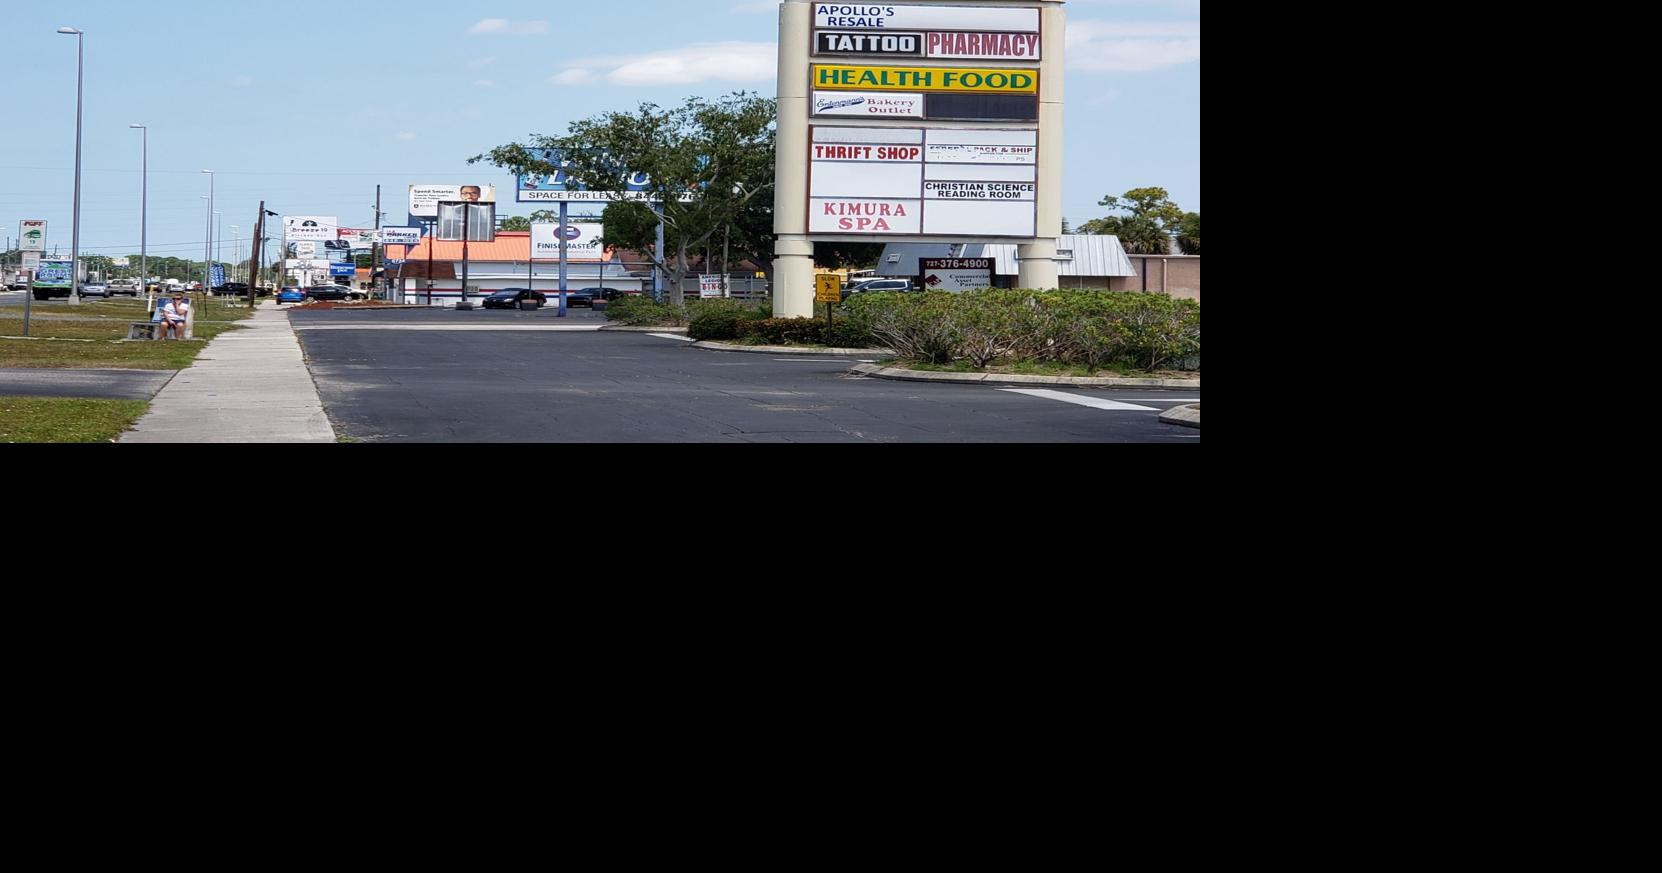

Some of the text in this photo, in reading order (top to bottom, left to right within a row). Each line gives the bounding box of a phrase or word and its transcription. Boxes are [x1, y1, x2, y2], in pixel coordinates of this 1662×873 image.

[818, 5, 894, 17] APOLLO'S
[827, 16, 885, 27] RESALE
[825, 34, 916, 52] TATTOO
[928, 33, 1039, 56] PHARMACY
[819, 69, 1032, 89] HEALTH FOOD
[867, 98, 915, 106] Bakery
[868, 106, 912, 114] Outlet
[815, 145, 919, 160] THRIFT SHOP
[925, 182, 1034, 192] CHRISTIAN SCIENCE
[528, 191, 562, 199] SPACE
[567, 191, 590, 199] FOR
[937, 190, 1021, 199] READING ROOM
[824, 202, 907, 217] KIMURA
[838, 217, 891, 231] SPA
[926, 259, 989, 268] 727-376-4900
